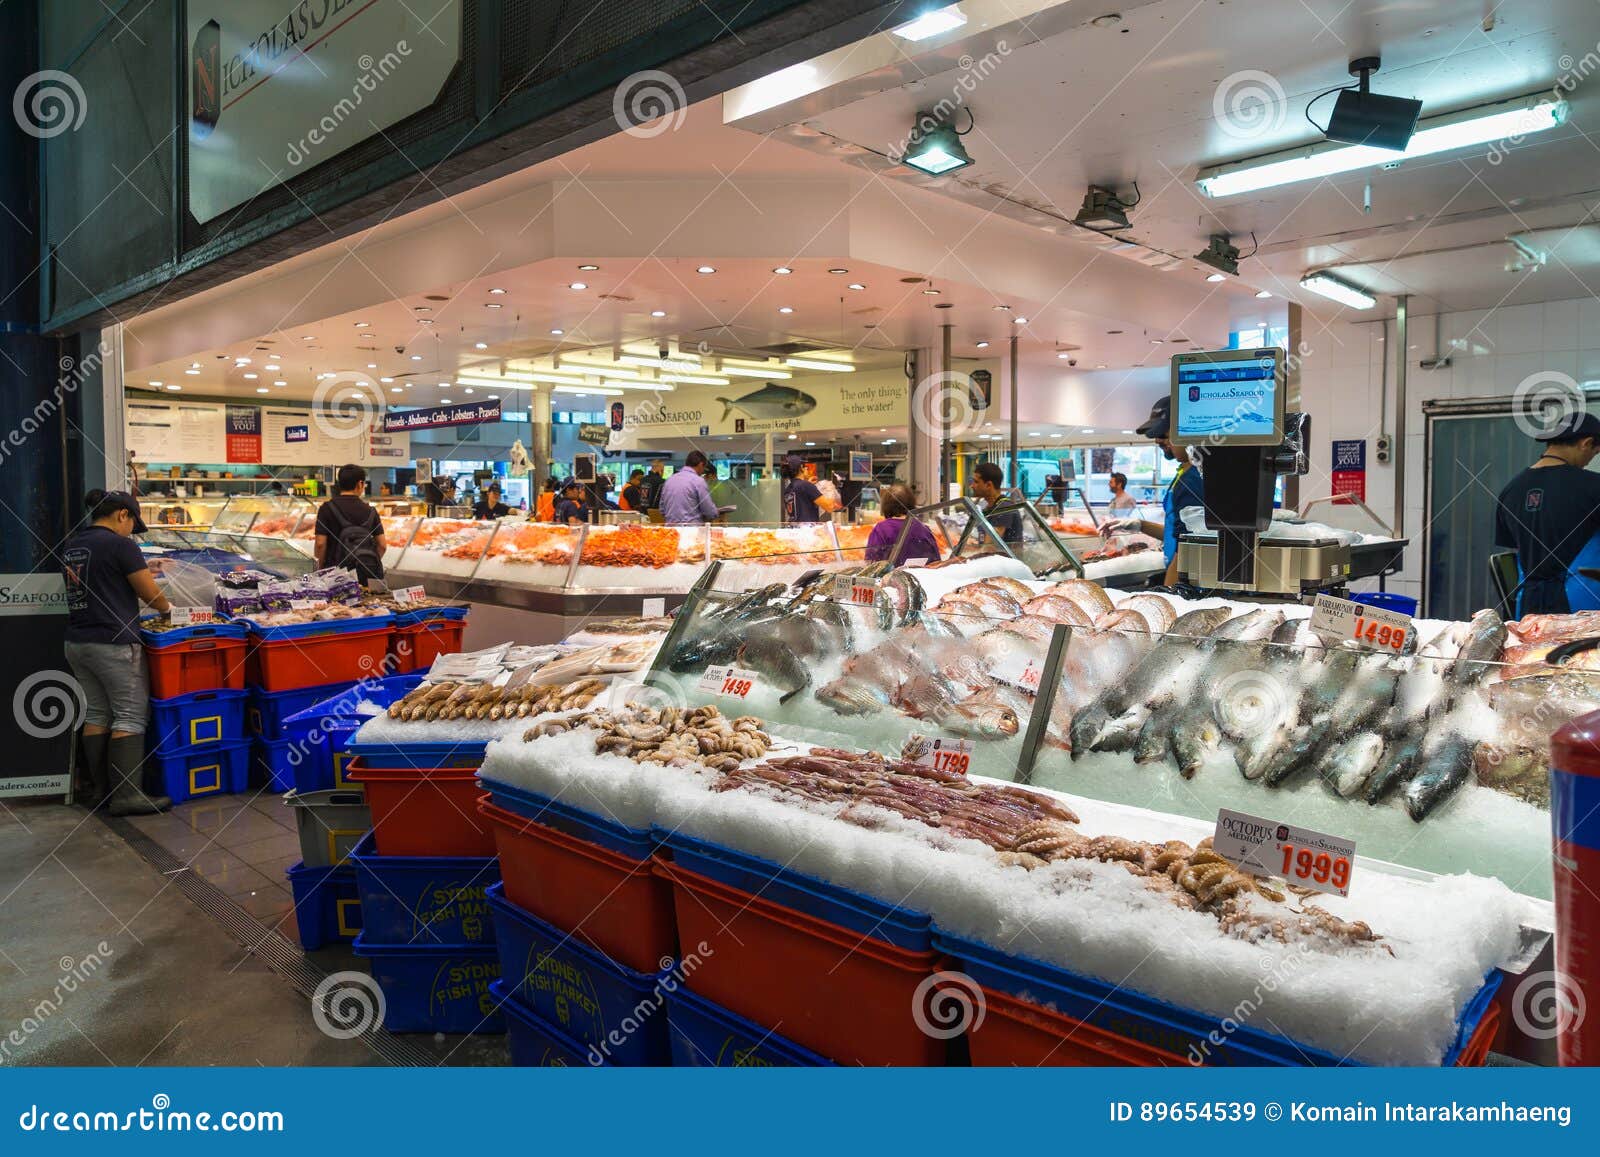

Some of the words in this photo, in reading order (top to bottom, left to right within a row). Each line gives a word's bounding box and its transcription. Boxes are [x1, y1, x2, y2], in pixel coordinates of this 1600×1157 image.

[857, 387, 876, 402] only
[878, 384, 901, 400] thing
[431, 411, 448, 423] Crabs
[451, 408, 475, 421] Lobsters
[478, 406, 499, 418] Prawns
[842, 404, 850, 414] is
[851, 403, 865, 413] the
[866, 401, 894, 412] water!
[775, 419, 800, 430] kingfish
[1338, 457, 1360, 465] YOU!
[190, 613, 212, 622] 2999
[721, 677, 753, 697] 1499
[933, 750, 970, 776] 1799
[1222, 817, 1273, 840] OCTOPUS
[1228, 831, 1264, 846] MEDIUM
[536, 951, 583, 986] SYDNEY
[436, 984, 472, 1004] FISH
[529, 974, 551, 991] FISH
[553, 976, 596, 1015] MARKET
